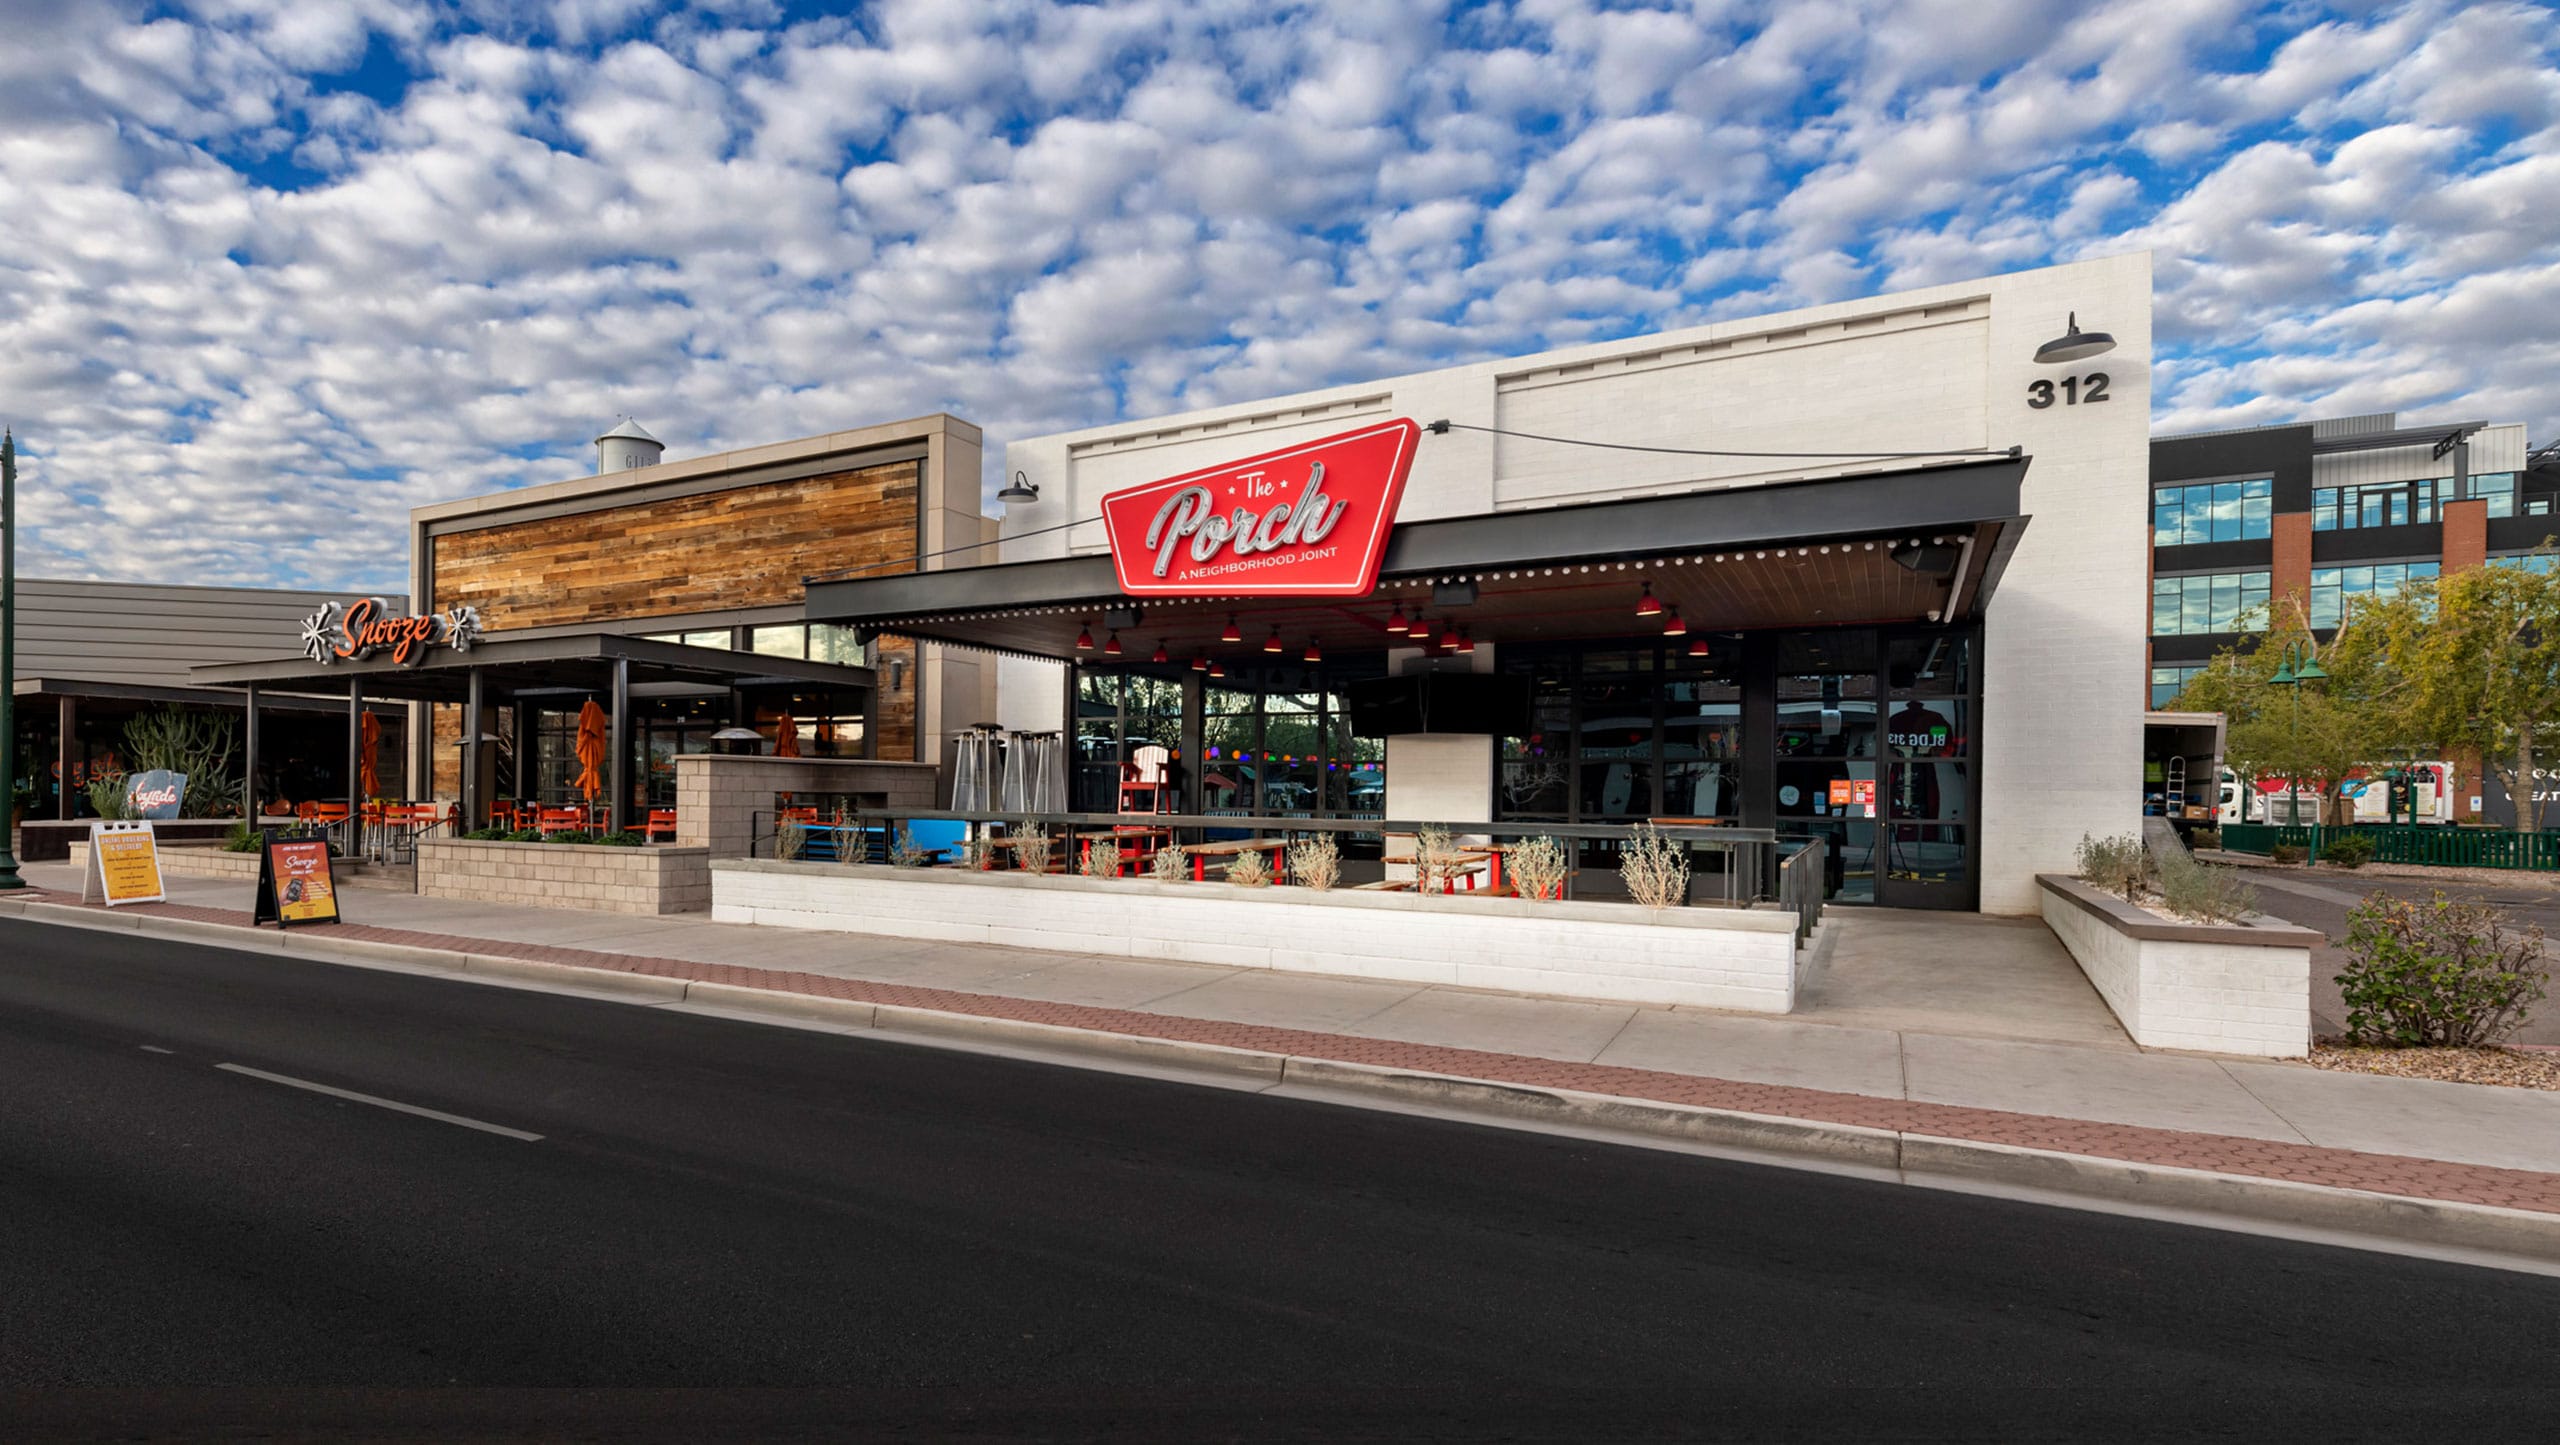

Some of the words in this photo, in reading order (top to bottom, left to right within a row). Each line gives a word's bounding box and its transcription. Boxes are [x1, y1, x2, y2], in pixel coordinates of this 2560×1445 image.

[2027, 372, 2110, 410] 312
[1236, 471, 1275, 498] The
[1145, 460, 1348, 577] Porch
[1178, 570, 1188, 581] A
[1189, 554, 1296, 579] NEIGHBORHOOD
[1297, 546, 1338, 563] JOINT
[334, 598, 433, 665] Snooze
[284, 855, 319, 869] Snooze
